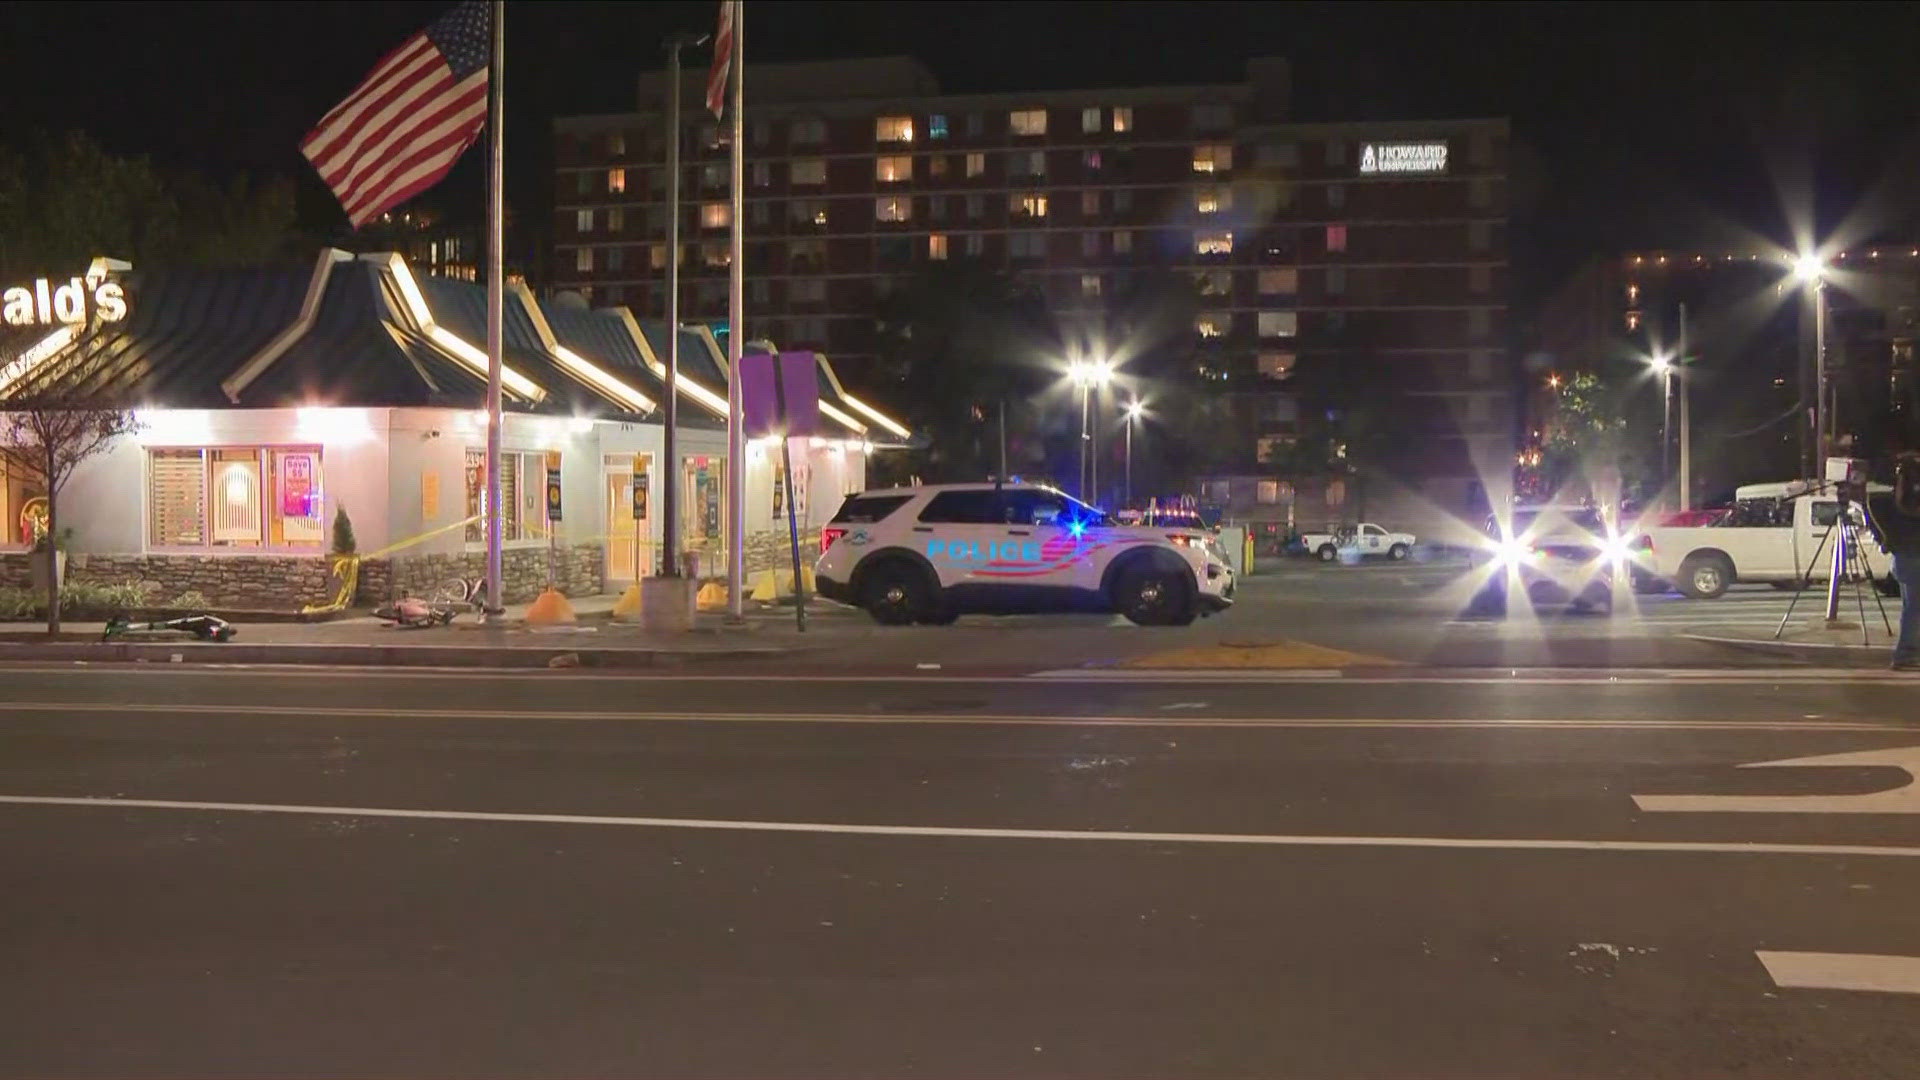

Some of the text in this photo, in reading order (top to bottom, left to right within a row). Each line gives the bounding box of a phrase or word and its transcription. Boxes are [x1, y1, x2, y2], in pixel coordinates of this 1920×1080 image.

[1378, 145, 1447, 159] HOWARD
[1378, 159, 1446, 172] UNIVERSITY
[926, 539, 1041, 561] POLICE
